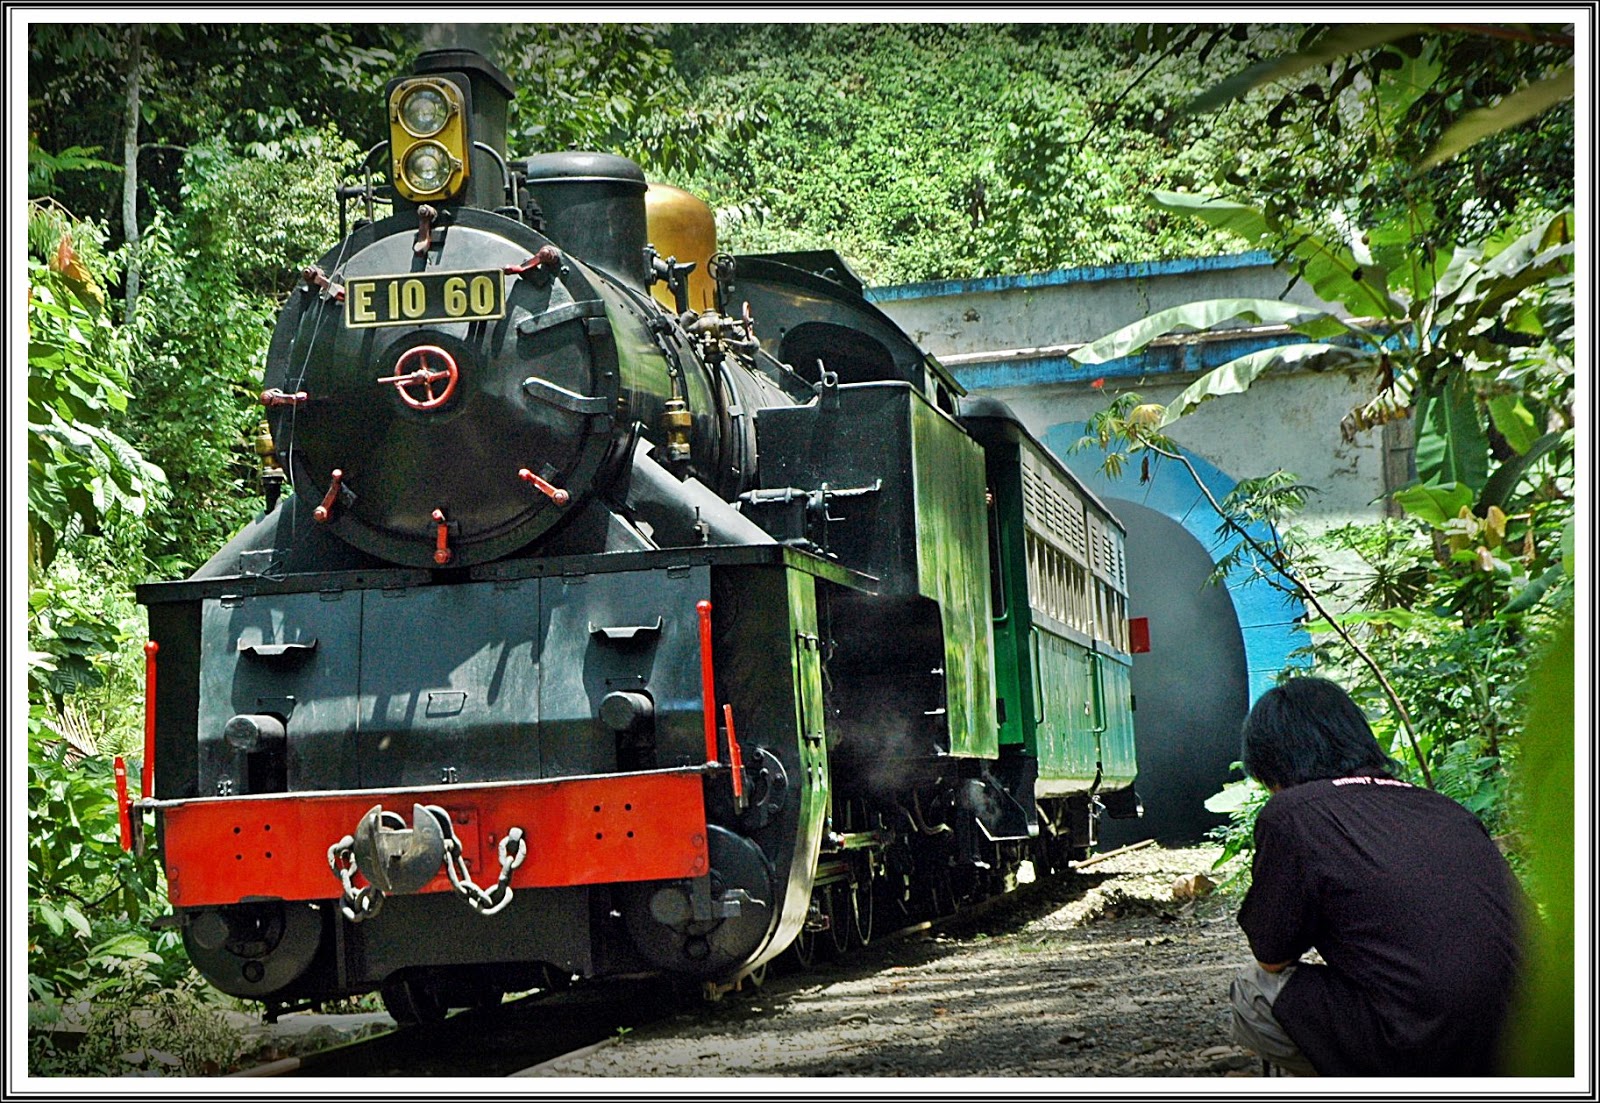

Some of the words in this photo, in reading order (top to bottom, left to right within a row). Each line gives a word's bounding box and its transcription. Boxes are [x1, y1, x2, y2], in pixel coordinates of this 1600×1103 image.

[354, 283, 376, 321] E
[388, 279, 426, 320] 10
[444, 275, 494, 317] 60
